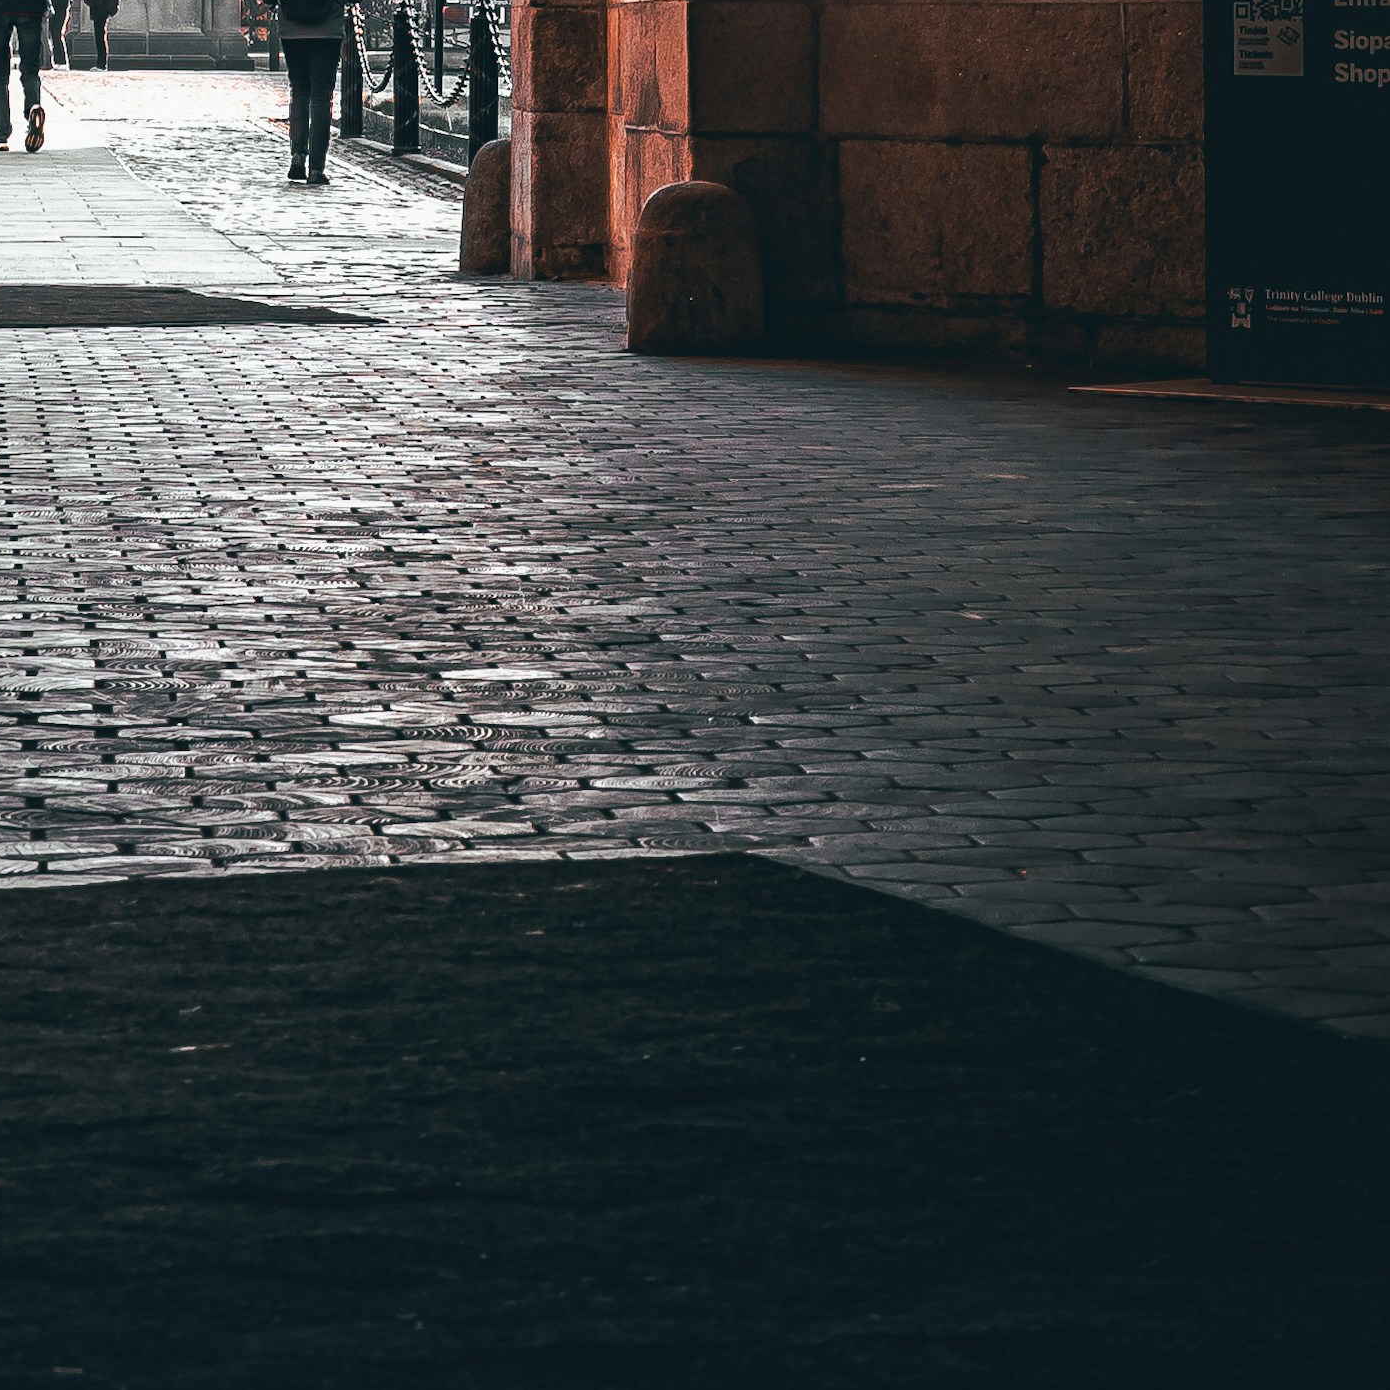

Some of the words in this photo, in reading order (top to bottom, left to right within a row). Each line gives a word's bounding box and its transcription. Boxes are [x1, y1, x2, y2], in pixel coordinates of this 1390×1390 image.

[1334, 62, 1390, 88] Shop
[1265, 289, 1300, 303] Trinity
[1304, 290, 1342, 304] College
[1346, 292, 1383, 304] Dublin
